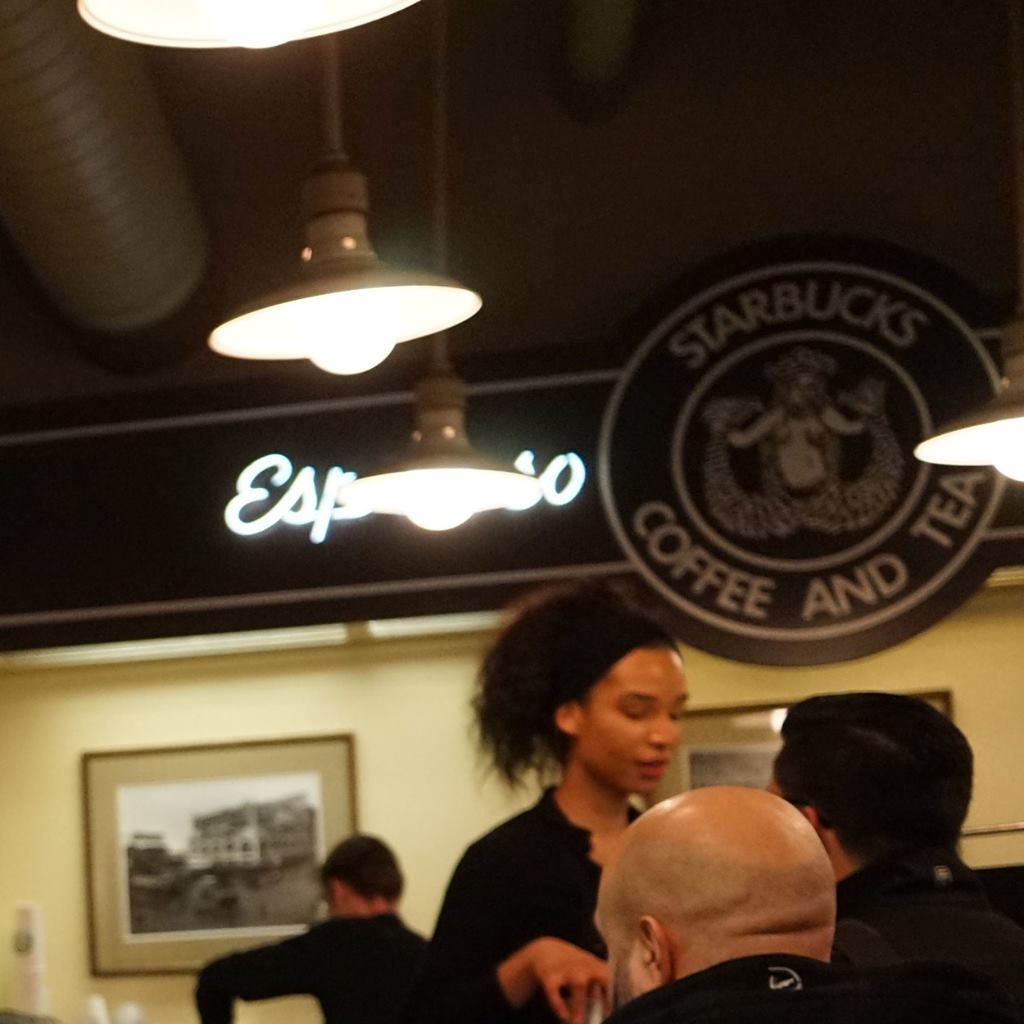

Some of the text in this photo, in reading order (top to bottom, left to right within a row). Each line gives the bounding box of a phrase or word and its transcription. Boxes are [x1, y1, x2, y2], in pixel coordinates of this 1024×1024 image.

[668, 280, 930, 369] STARBUCKS
[224, 450, 586, 544] Espo
[632, 470, 987, 621] COFFEE AND TEA
